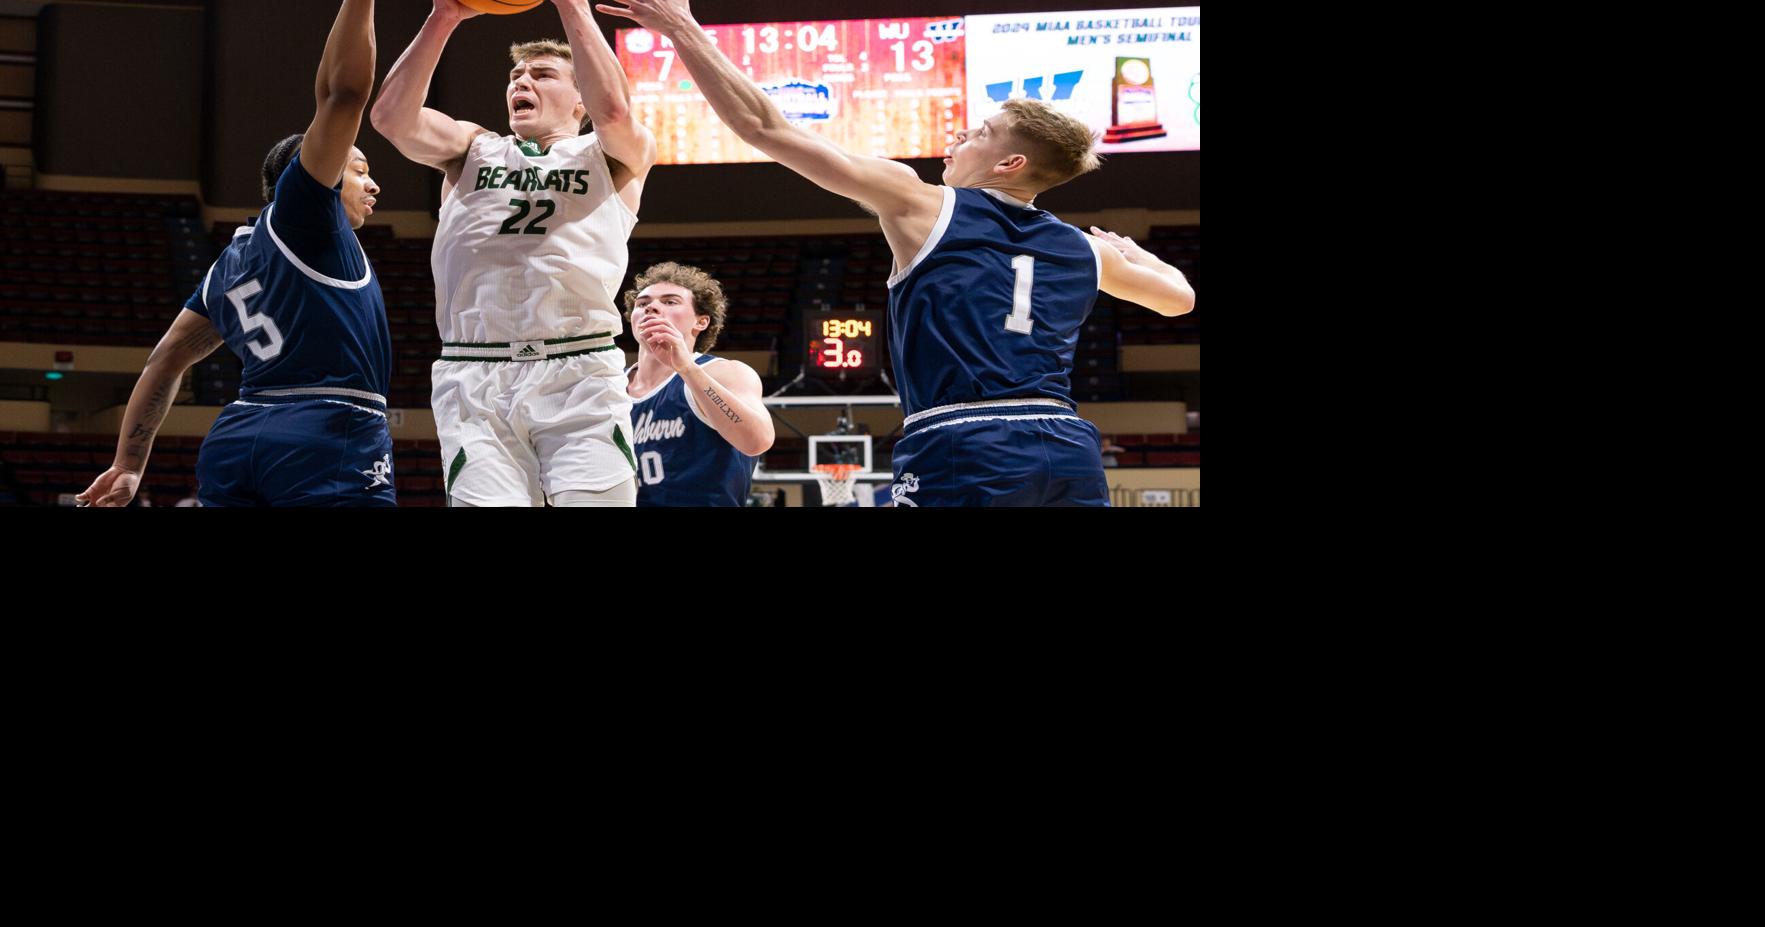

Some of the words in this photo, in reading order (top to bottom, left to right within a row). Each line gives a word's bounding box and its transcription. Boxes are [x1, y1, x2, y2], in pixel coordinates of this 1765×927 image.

[742, 24, 839, 53] 13:04
[992, 23, 1030, 34] 2024
[1036, 21, 1070, 31] MIAA
[1076, 17, 1162, 30] BASKETBALL
[1067, 34, 1111, 45] MEN'S
[1117, 31, 1191, 43] SEMIFINAL
[652, 51, 675, 81] 7
[890, 40, 935, 72] 13
[474, 166, 590, 195] BEARCATS
[498, 198, 556, 235] 22
[1003, 254, 1036, 336] 1
[225, 278, 285, 363] 5
[823, 319, 872, 338] 13:04
[823, 338, 862, 368] 3.0
[633, 409, 686, 444] hburn
[637, 450, 665, 487] 0
